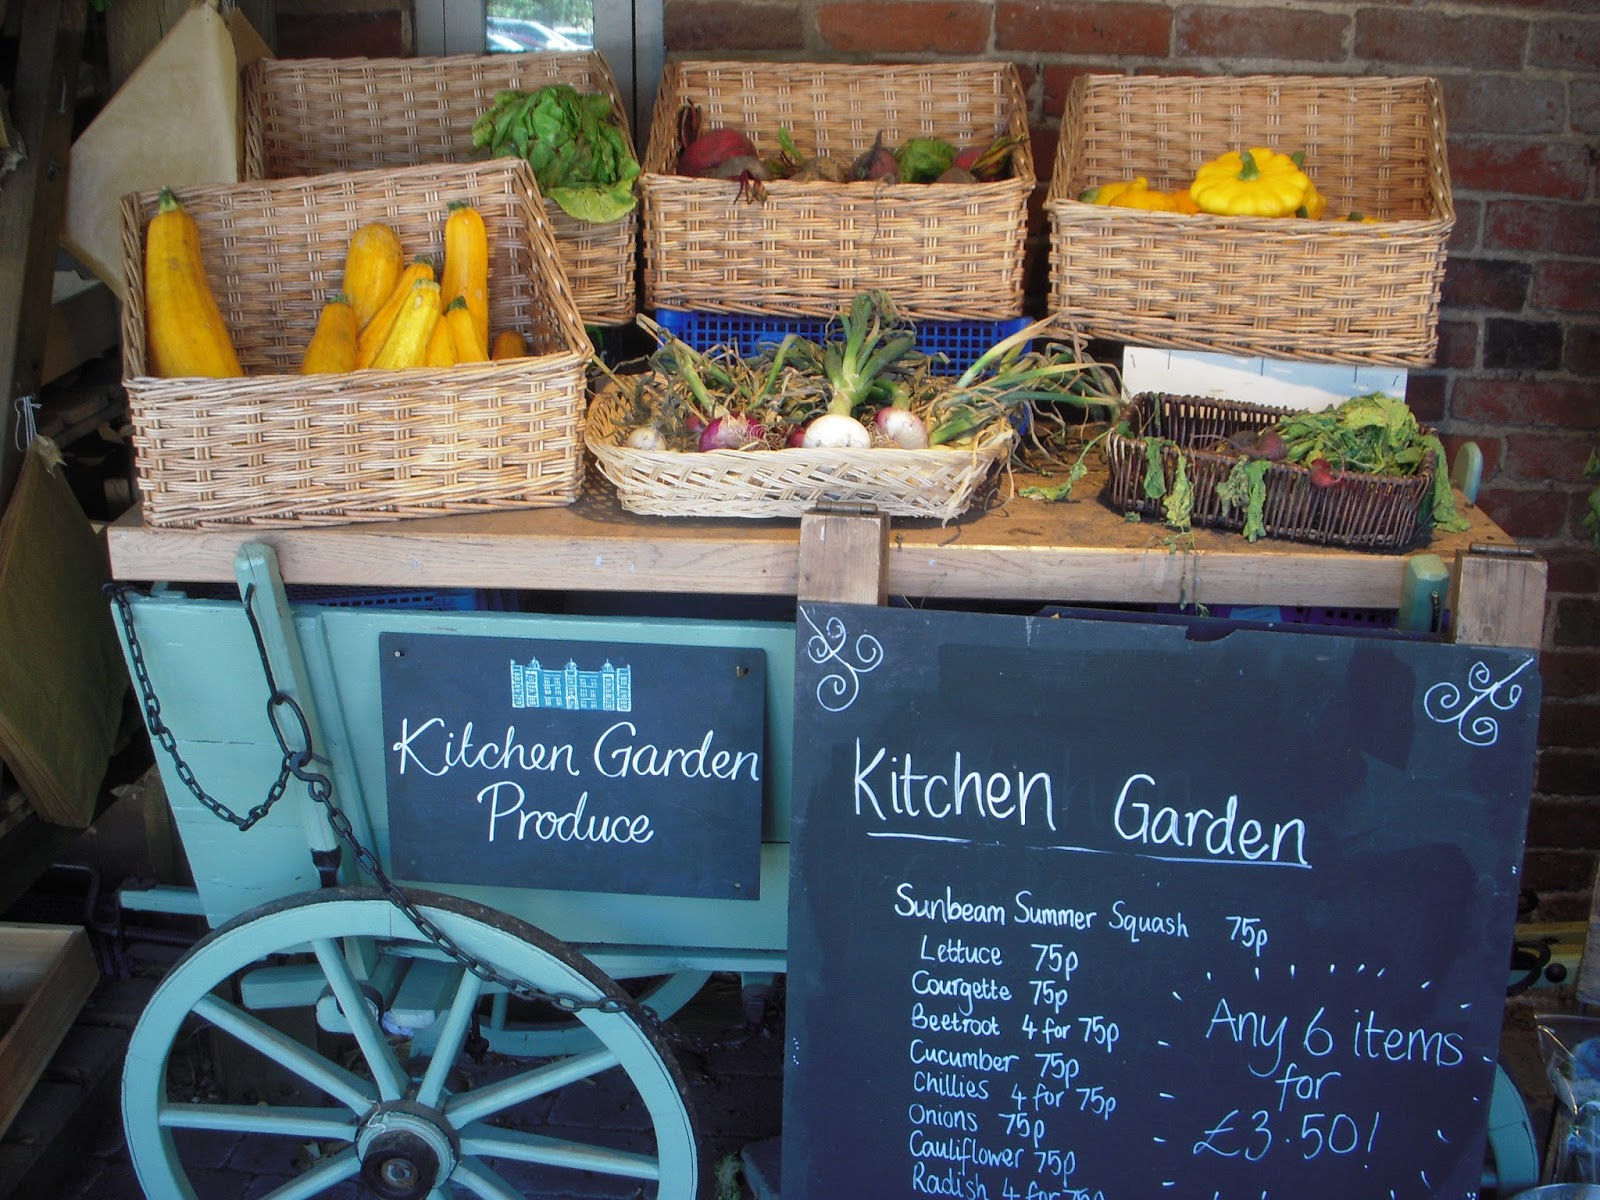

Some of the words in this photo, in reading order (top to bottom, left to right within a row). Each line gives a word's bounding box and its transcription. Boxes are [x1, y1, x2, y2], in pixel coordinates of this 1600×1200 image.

[393, 717, 579, 776] Kitchen
[594, 721, 759, 781] Garden
[477, 781, 654, 842] Produce
[854, 738, 1057, 830] Kitchen
[1114, 774, 1308, 866] Garden
[895, 883, 1005, 926] Sunbeam
[1014, 890, 1098, 930] Summer
[1109, 900, 1190, 942] Squash
[1226, 916, 1268, 956] 75p
[920, 935, 1003, 965] Lettuce
[1031, 944, 1079, 979] 75p
[911, 970, 1012, 1016] Courgette
[1029, 980, 1068, 1014] 75p
[911, 1003, 1000, 1035] Beetroot
[1022, 1014, 1037, 1040] 4
[1042, 1017, 1071, 1044] for
[1078, 1016, 1120, 1052] 75p
[1206, 999, 1287, 1078] Any
[1303, 1008, 1333, 1057] 6
[1353, 1008, 1463, 1066] items
[910, 1039, 1019, 1072] Cucumber
[1035, 1053, 1080, 1089] 75p
[1275, 1063, 1342, 1112] for
[914, 1071, 989, 1100] Chillies
[1011, 1084, 1026, 1110] 4
[1033, 1081, 1064, 1109] for
[1076, 1086, 1117, 1120] 75p
[909, 1104, 978, 1131] Onions
[998, 1113, 1045, 1148] 75p
[909, 1130, 1024, 1175] Cauliflower
[1034, 1150, 1076, 1187] 75p
[912, 1161, 988, 1200] Radish
[1002, 1178, 1019, 1200] 4
